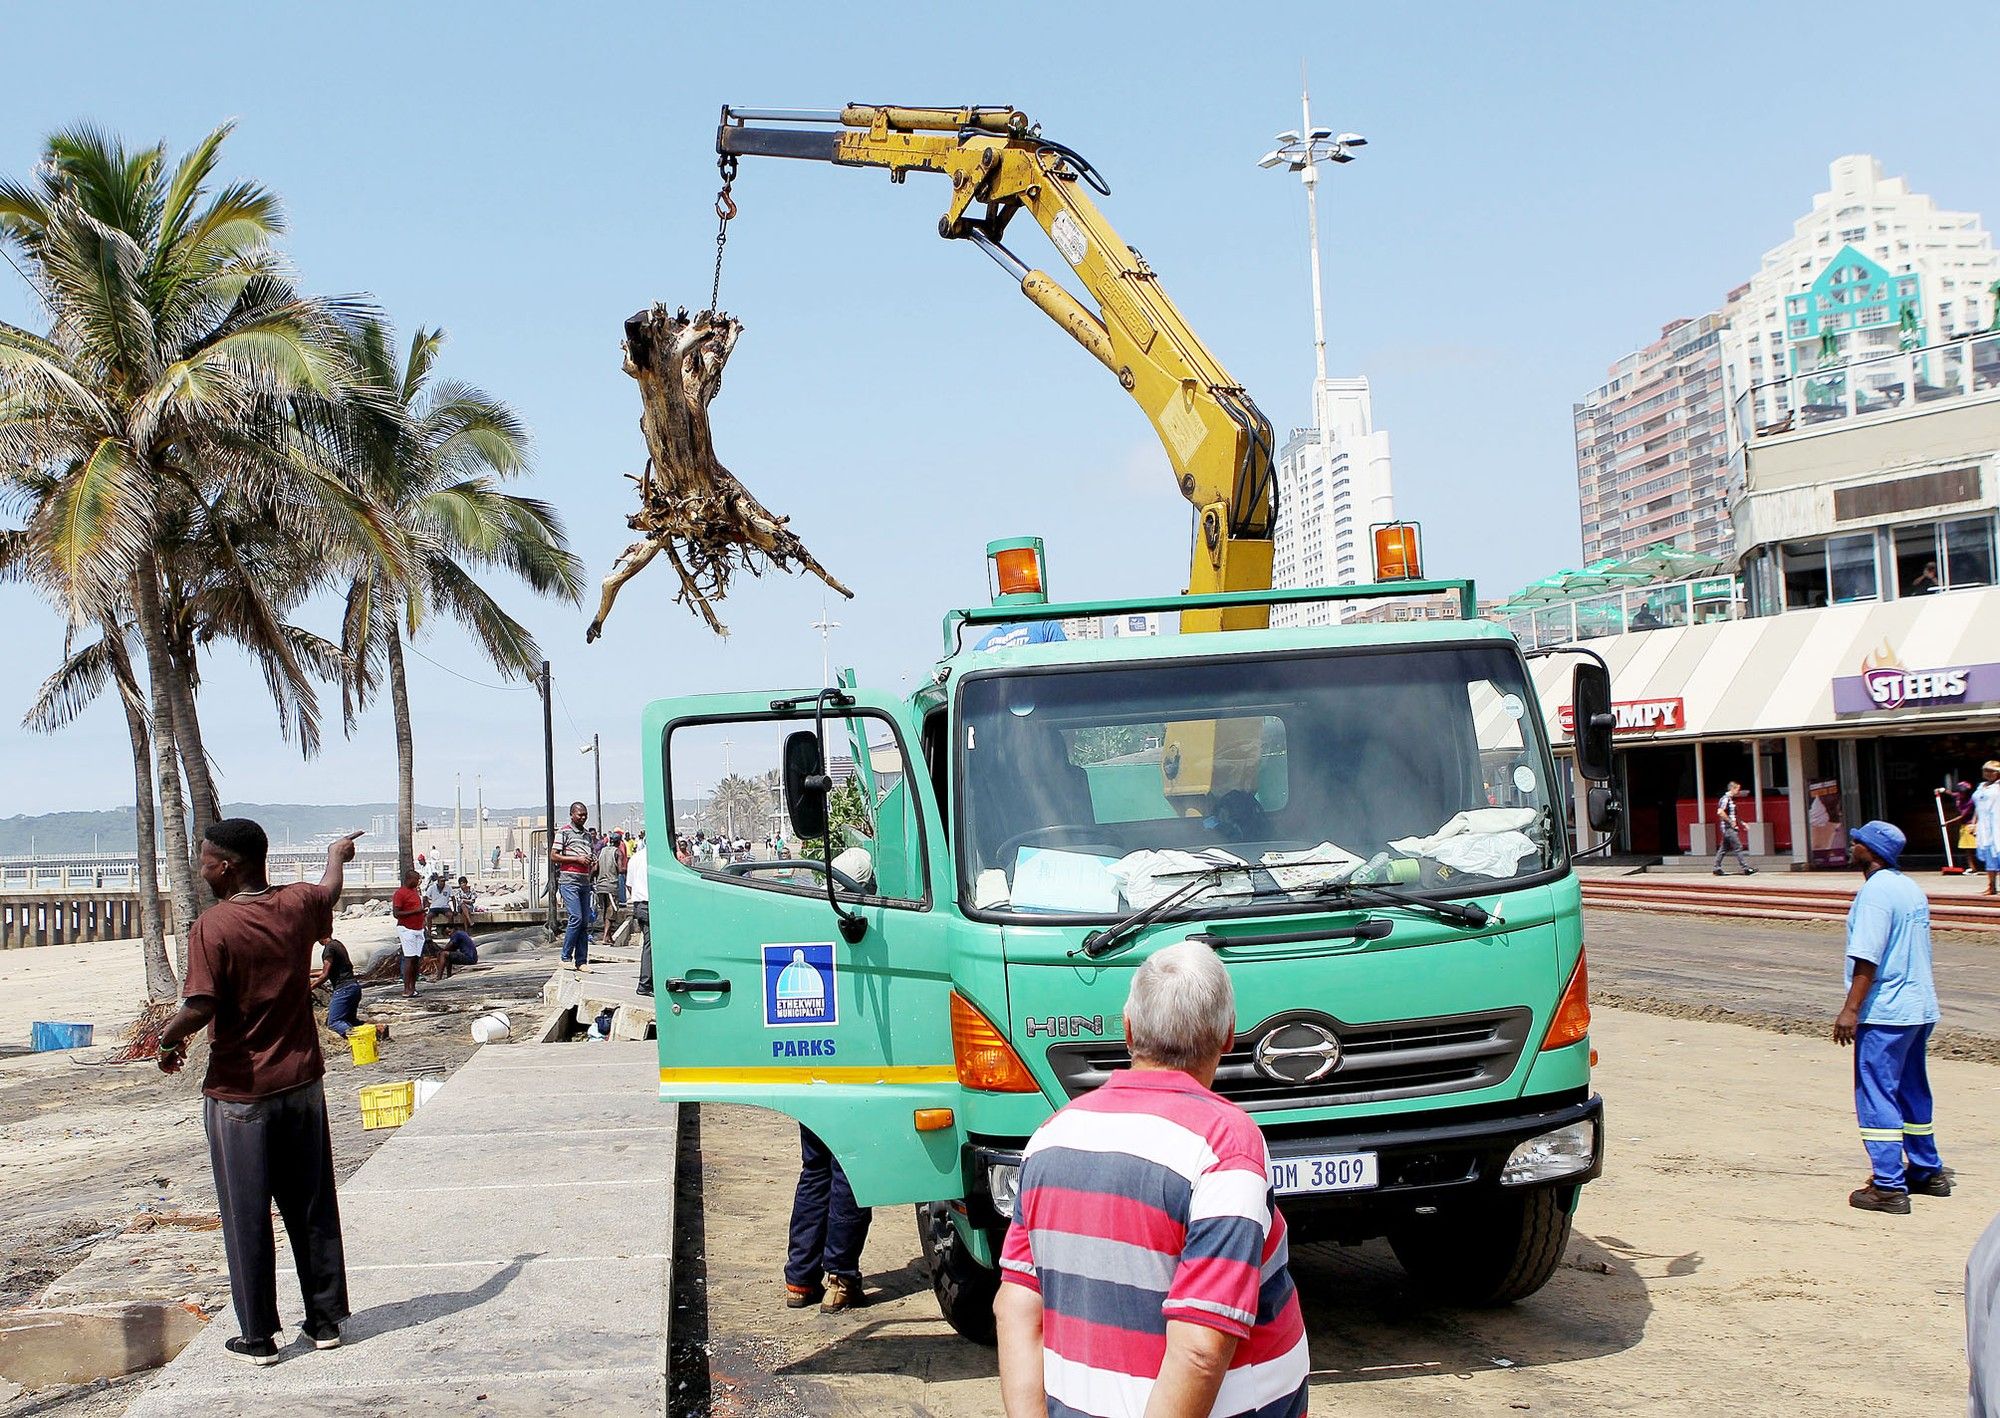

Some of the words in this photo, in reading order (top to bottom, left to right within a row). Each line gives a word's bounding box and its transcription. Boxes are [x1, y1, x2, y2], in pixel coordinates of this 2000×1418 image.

[1871, 670, 1969, 703] STEERS
[1612, 702, 1678, 729] IMPY
[777, 998, 825, 1009] ETHEKWINI
[777, 1007, 825, 1018] MUNICIPALITY
[772, 1039, 836, 1057] PARKS
[1311, 1158, 1363, 1187] 3809
